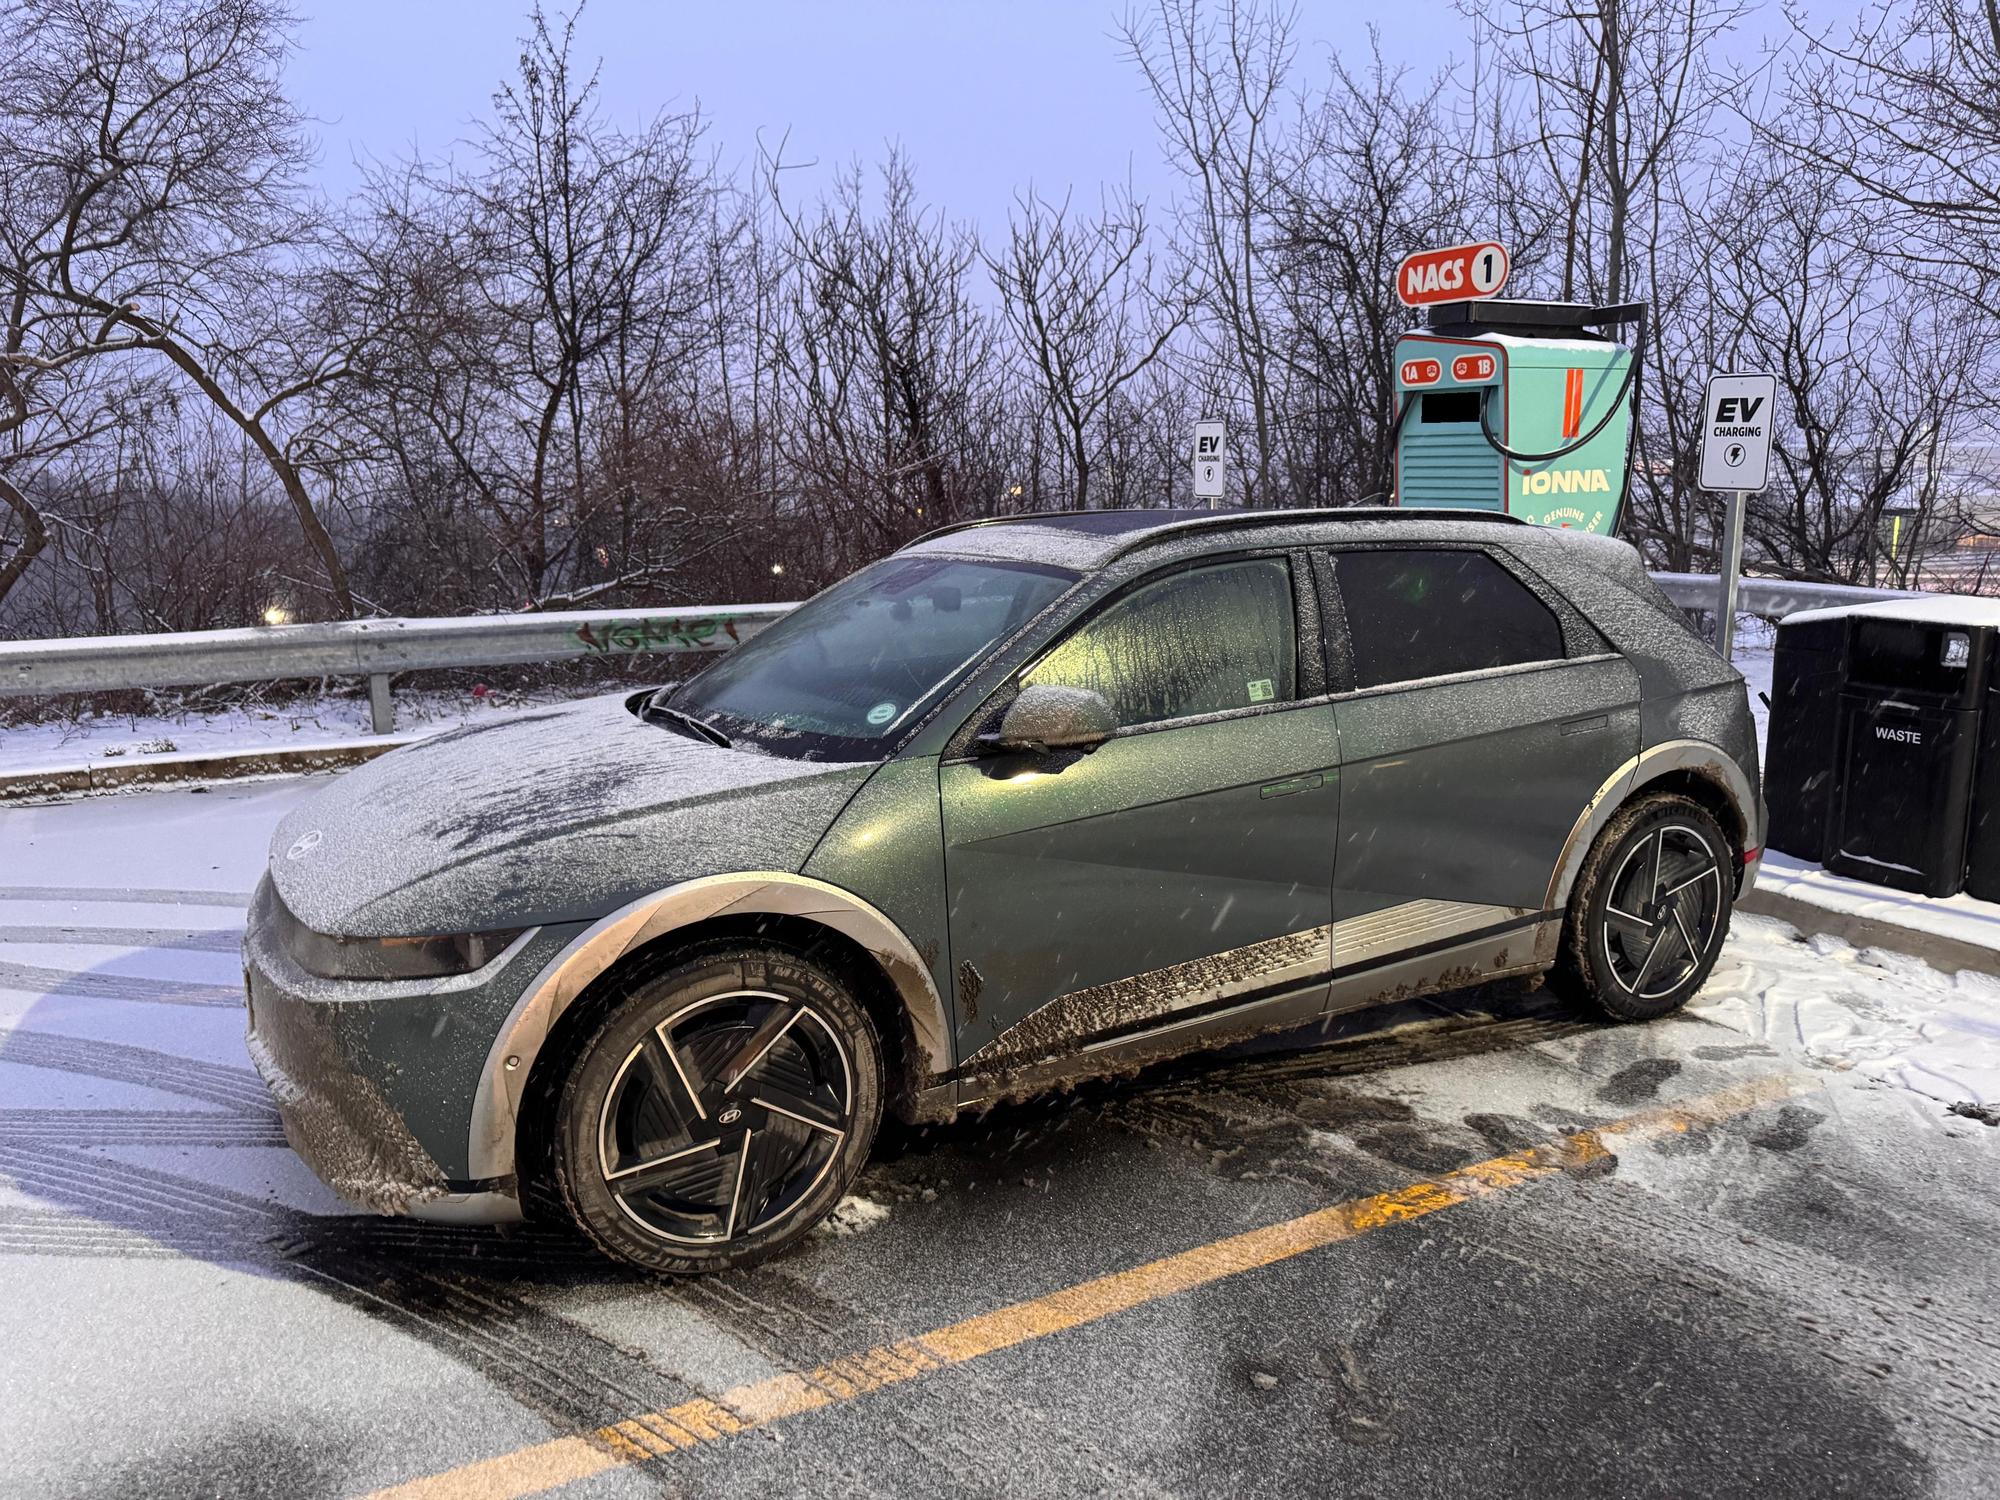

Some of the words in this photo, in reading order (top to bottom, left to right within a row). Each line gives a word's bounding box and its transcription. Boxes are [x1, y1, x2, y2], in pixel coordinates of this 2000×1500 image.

[1407, 258, 1464, 295] NACS
[1483, 254, 1493, 284] 1
[1404, 365, 1418, 380] 1A
[1477, 359, 1491, 375] 1B
[1715, 397, 1764, 423] EV
[1713, 426, 1762, 437] CHARGING
[1199, 436, 1220, 453] EV
[1543, 507, 1585, 525] GENUINE
[1875, 726, 1921, 744] WASTE
